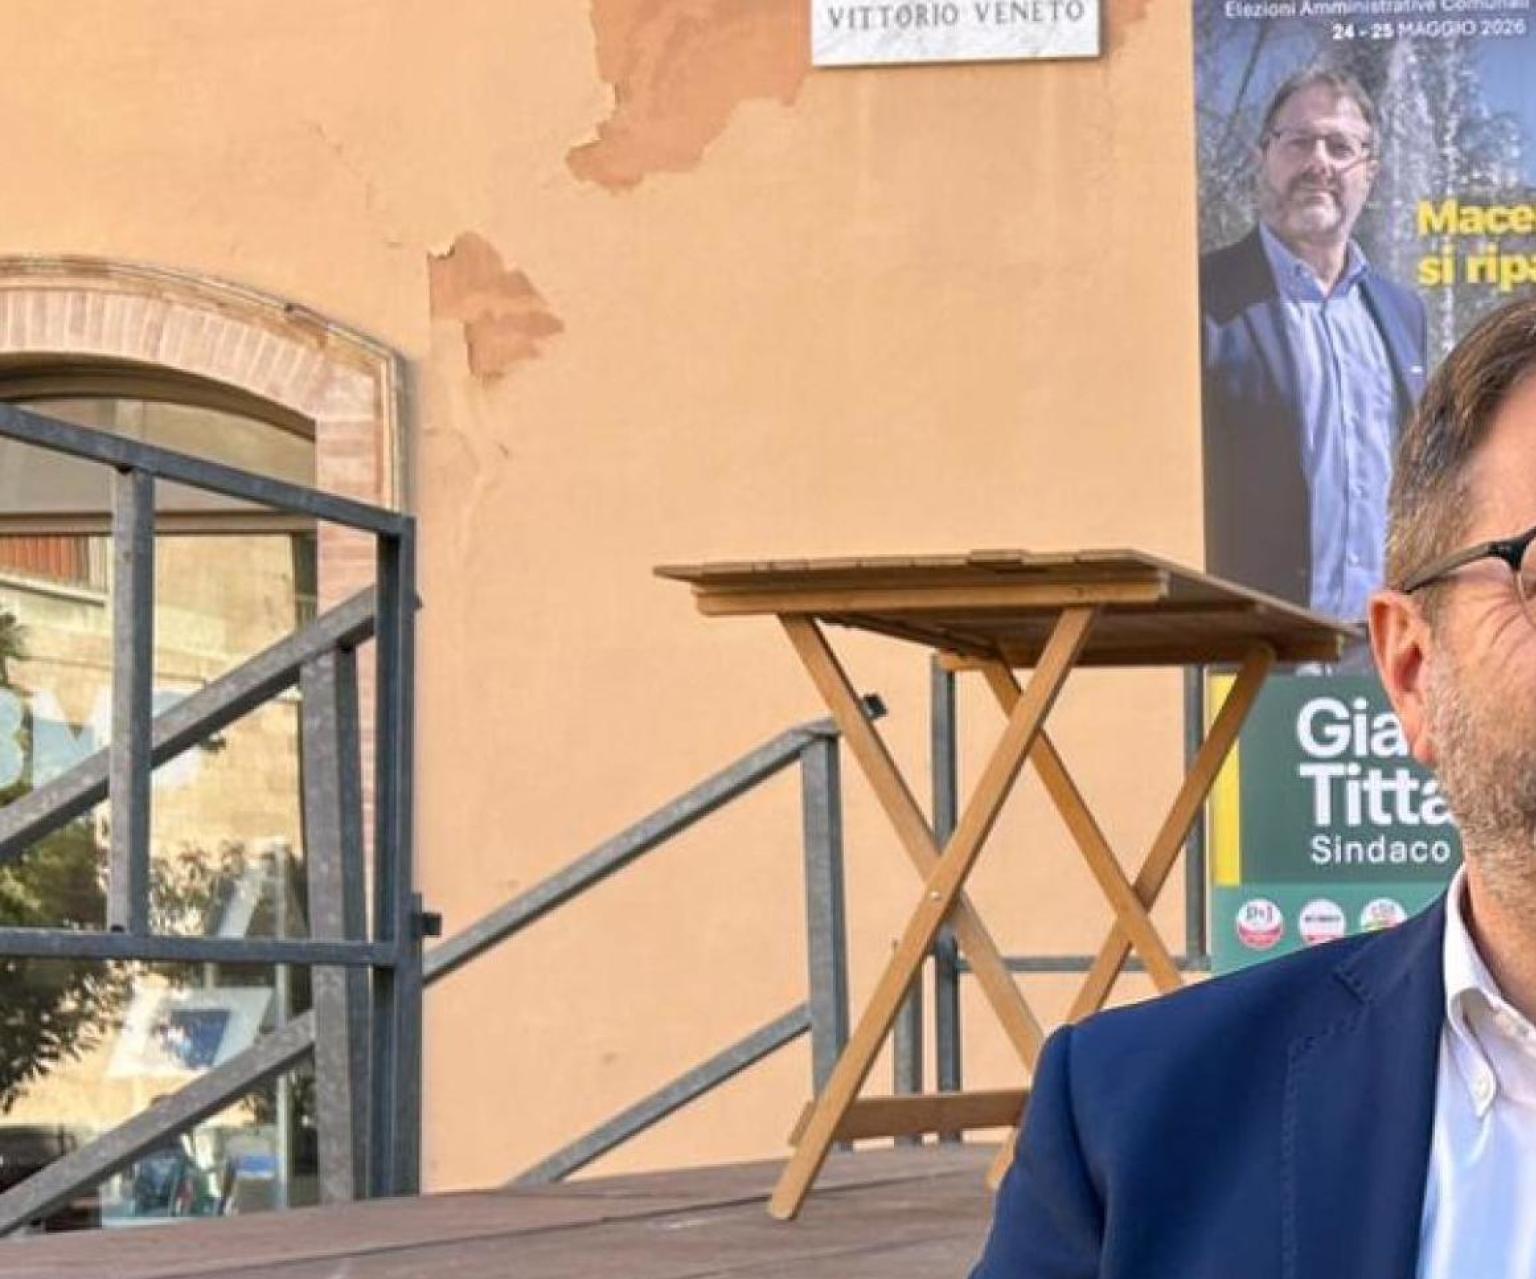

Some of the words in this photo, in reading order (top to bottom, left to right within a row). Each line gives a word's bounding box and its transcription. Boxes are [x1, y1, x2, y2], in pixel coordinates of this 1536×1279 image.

[827, 4, 959, 31] VITTORIO
[974, 0, 1086, 25] VENETO
[1332, 23, 1354, 41] 24
[1370, 22, 1394, 39] 25
[1398, 19, 1477, 38] MAGGIO
[1481, 16, 1528, 36] 2026
[1418, 246, 1455, 287] si
[1309, 833, 1451, 866] Sindaco
